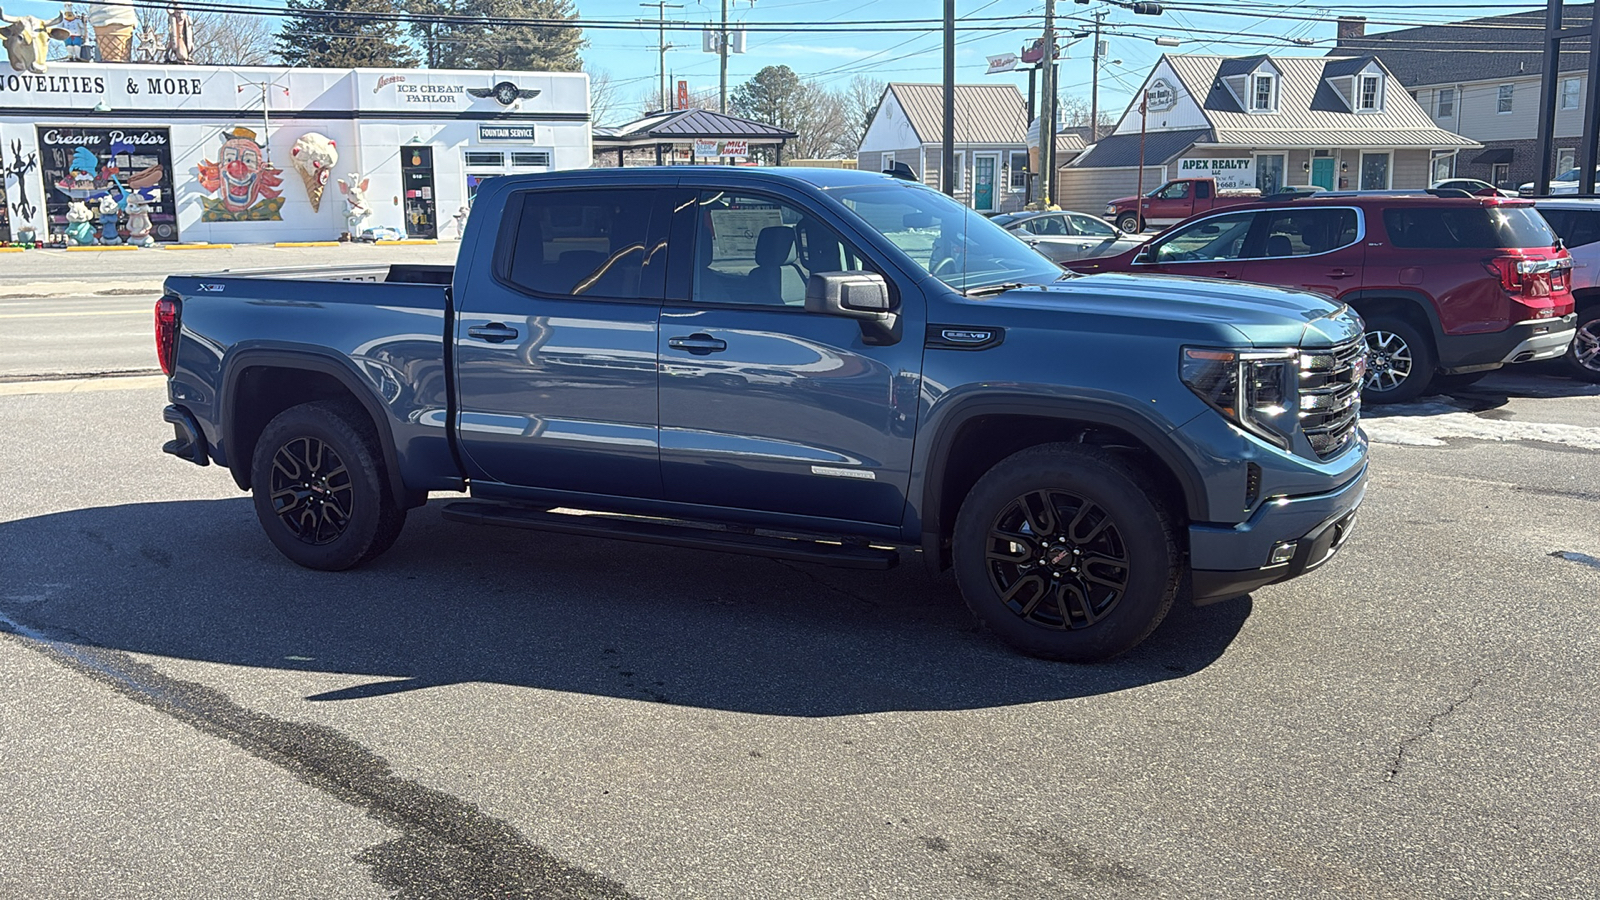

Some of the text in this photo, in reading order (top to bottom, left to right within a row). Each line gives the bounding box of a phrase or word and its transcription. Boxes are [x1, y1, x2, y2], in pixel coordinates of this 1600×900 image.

[126, 77, 139, 95] &
[147, 78, 202, 95] MORE
[397, 84, 464, 94] ICE CREAM
[406, 94, 456, 103] PARLOR
[43, 129, 167, 145] Cream Parlor
[481, 128, 533, 138] FOUNTAIN SERVICE
[1182, 160, 1250, 170] APEX REALTY
